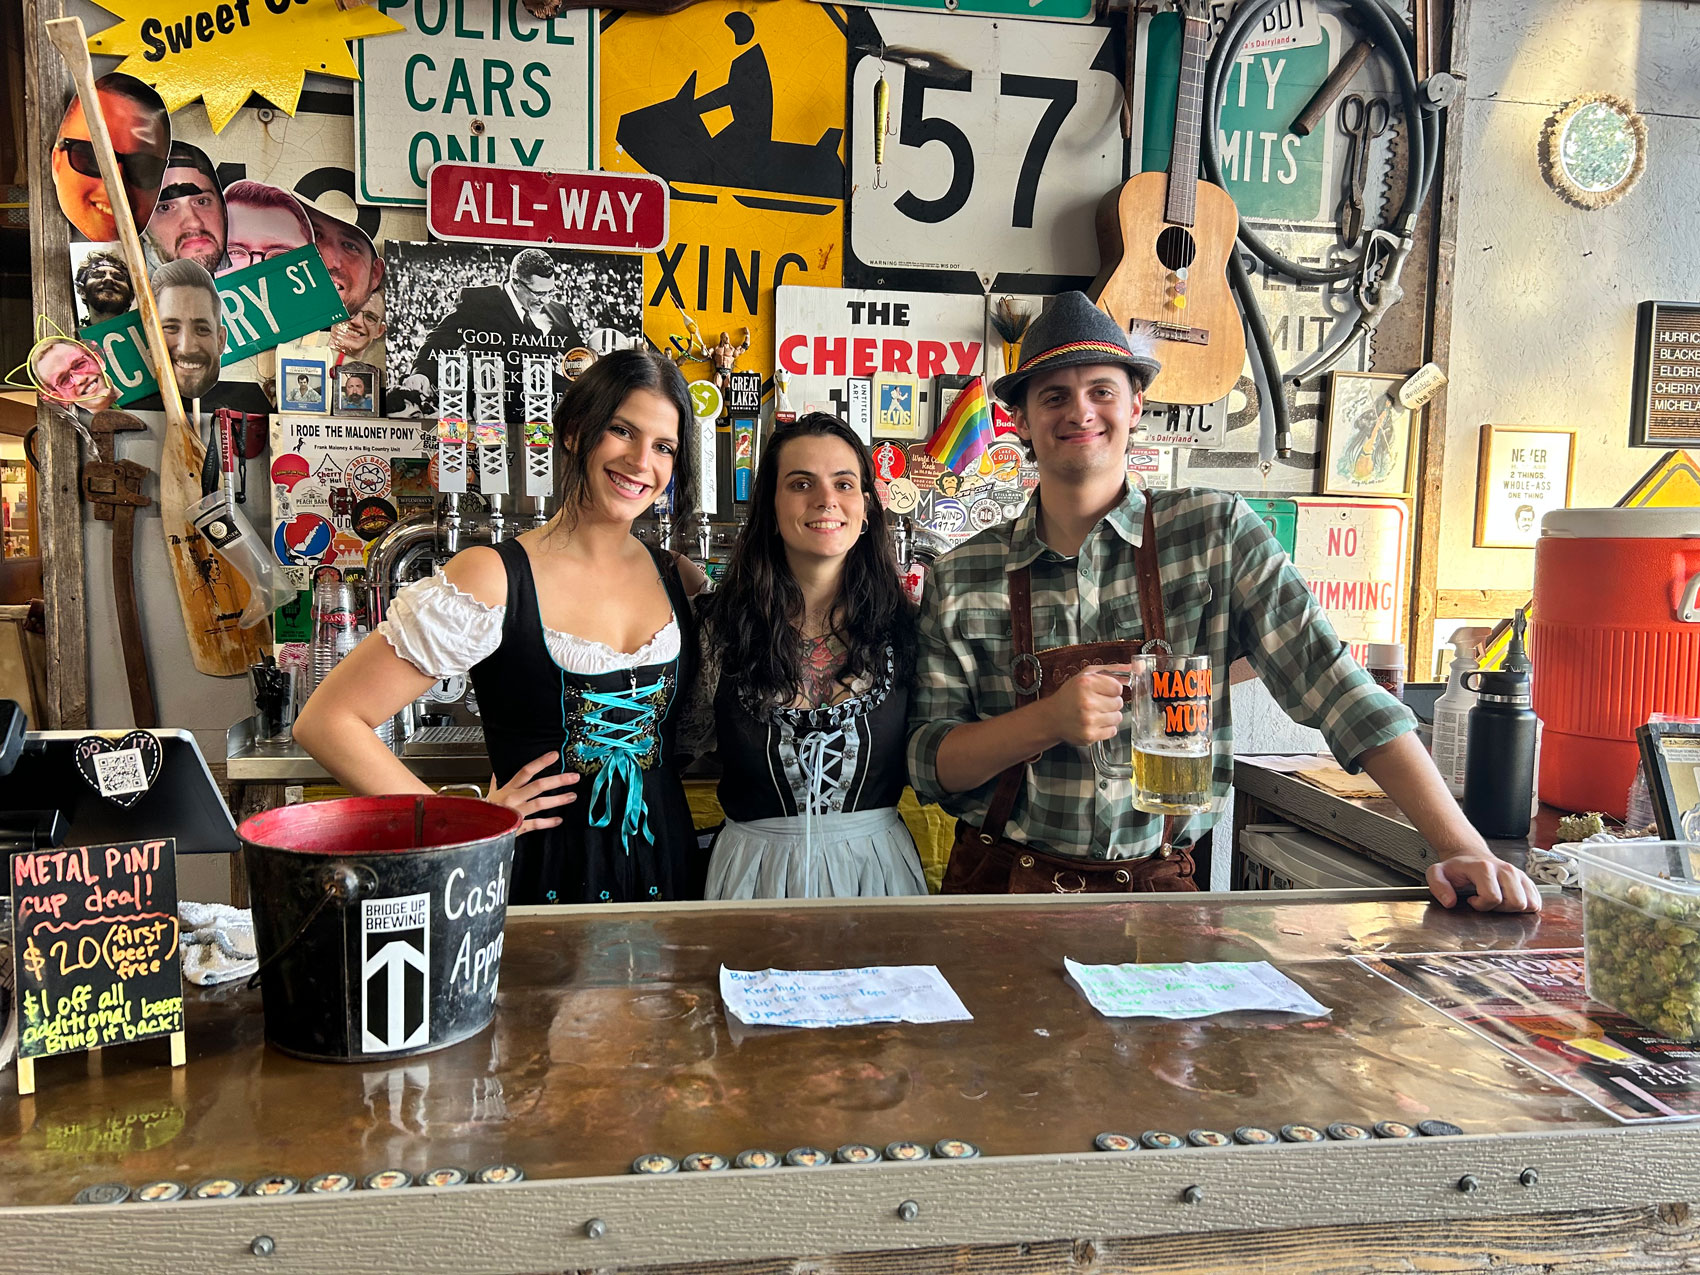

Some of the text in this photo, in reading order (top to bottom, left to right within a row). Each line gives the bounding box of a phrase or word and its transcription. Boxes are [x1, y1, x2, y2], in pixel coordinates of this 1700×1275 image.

[141, 3, 250, 62] Sweet
[1256, 36, 1290, 47] Dairyland
[405, 54, 551, 118] CARS
[893, 66, 1078, 229] 57
[285, 259, 318, 295] ST
[847, 300, 910, 327] THE
[511, 332, 569, 348] FAMILY
[778, 335, 982, 379] CHERRY
[732, 376, 760, 391] GREAT
[1655, 382, 1700, 395] CHERRY
[731, 392, 759, 406] LAKES
[880, 409, 911, 425] ELVIS
[290, 424, 414, 441] I RODE THE MALONEY PONY
[1157, 434, 1192, 444] Dairyland
[328, 445, 348, 453] Maloney
[372, 446, 389, 454] Country
[912, 453, 931, 463] World
[993, 453, 1017, 461] LOUIE
[352, 456, 390, 473] ABLE BAKER
[922, 462, 936, 470] Rock
[317, 471, 342, 482] Cherry
[1510, 471, 1516, 479] 2
[1503, 480, 1551, 490] WHOLE-ASS
[935, 511, 962, 520] EWIND
[972, 501, 1001, 516] RAISED GRAIN
[938, 521, 956, 532] 97.7
[1327, 527, 1358, 557] NO
[1307, 581, 1392, 611] WIMMING
[1152, 669, 1212, 699] MACHO
[1165, 703, 1208, 734] MUG
[81, 743, 101, 760] DO
[15, 847, 99, 886] METAL
[22, 877, 153, 919] cup deal!
[444, 861, 505, 921] Cash
[366, 899, 426, 917] BRIDGE UP
[366, 912, 426, 931] BREWING
[112, 943, 161, 960] beer
[58, 985, 92, 1014] off
[99, 982, 125, 1009] all
[22, 999, 131, 1044] additional
[45, 1015, 181, 1054] Bring it back!
[1625, 1064, 1692, 1076] FALL
